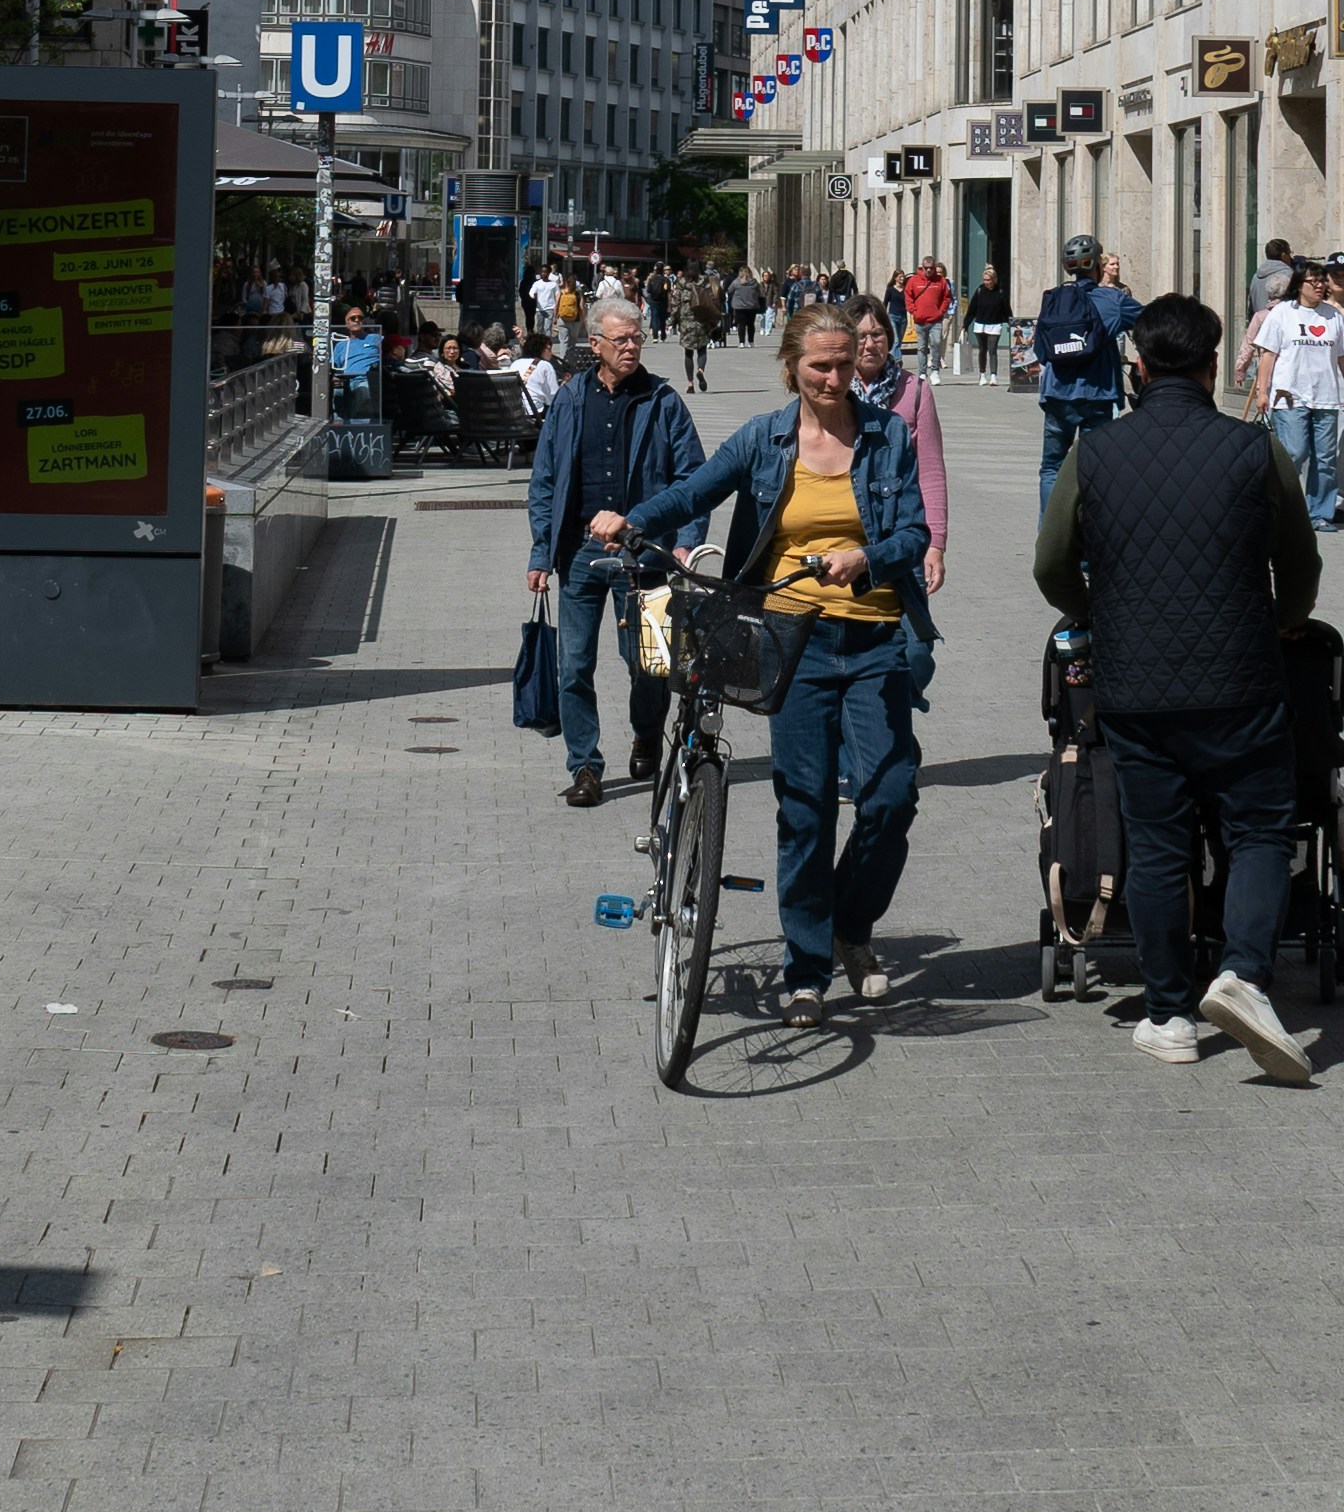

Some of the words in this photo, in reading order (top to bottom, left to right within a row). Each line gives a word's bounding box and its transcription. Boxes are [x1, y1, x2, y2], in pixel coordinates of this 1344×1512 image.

[365, 32, 395, 55] H&M
[806, 34, 831, 51] P&C
[301, 34, 353, 98] U
[777, 60, 801, 75] P&C
[754, 80, 775, 94] P&C
[734, 97, 754, 111] P&C
[59, 260, 100, 273] 20.-28.
[102, 258, 133, 270] JUNI
[88, 284, 154, 297] HANNOVER
[0, 325, 34, 335] 4HUGS
[94, 319, 132, 329] EINTRITT
[134, 317, 153, 327] FREI
[1298, 323, 1308, 337] I
[18, 335, 56, 347] HÄGELE
[1292, 339, 1335, 347] THAILAND
[25, 404, 69, 420] 27.06.
[74, 428, 98, 438] LORI
[38, 452, 138, 474] ZARTMANN
